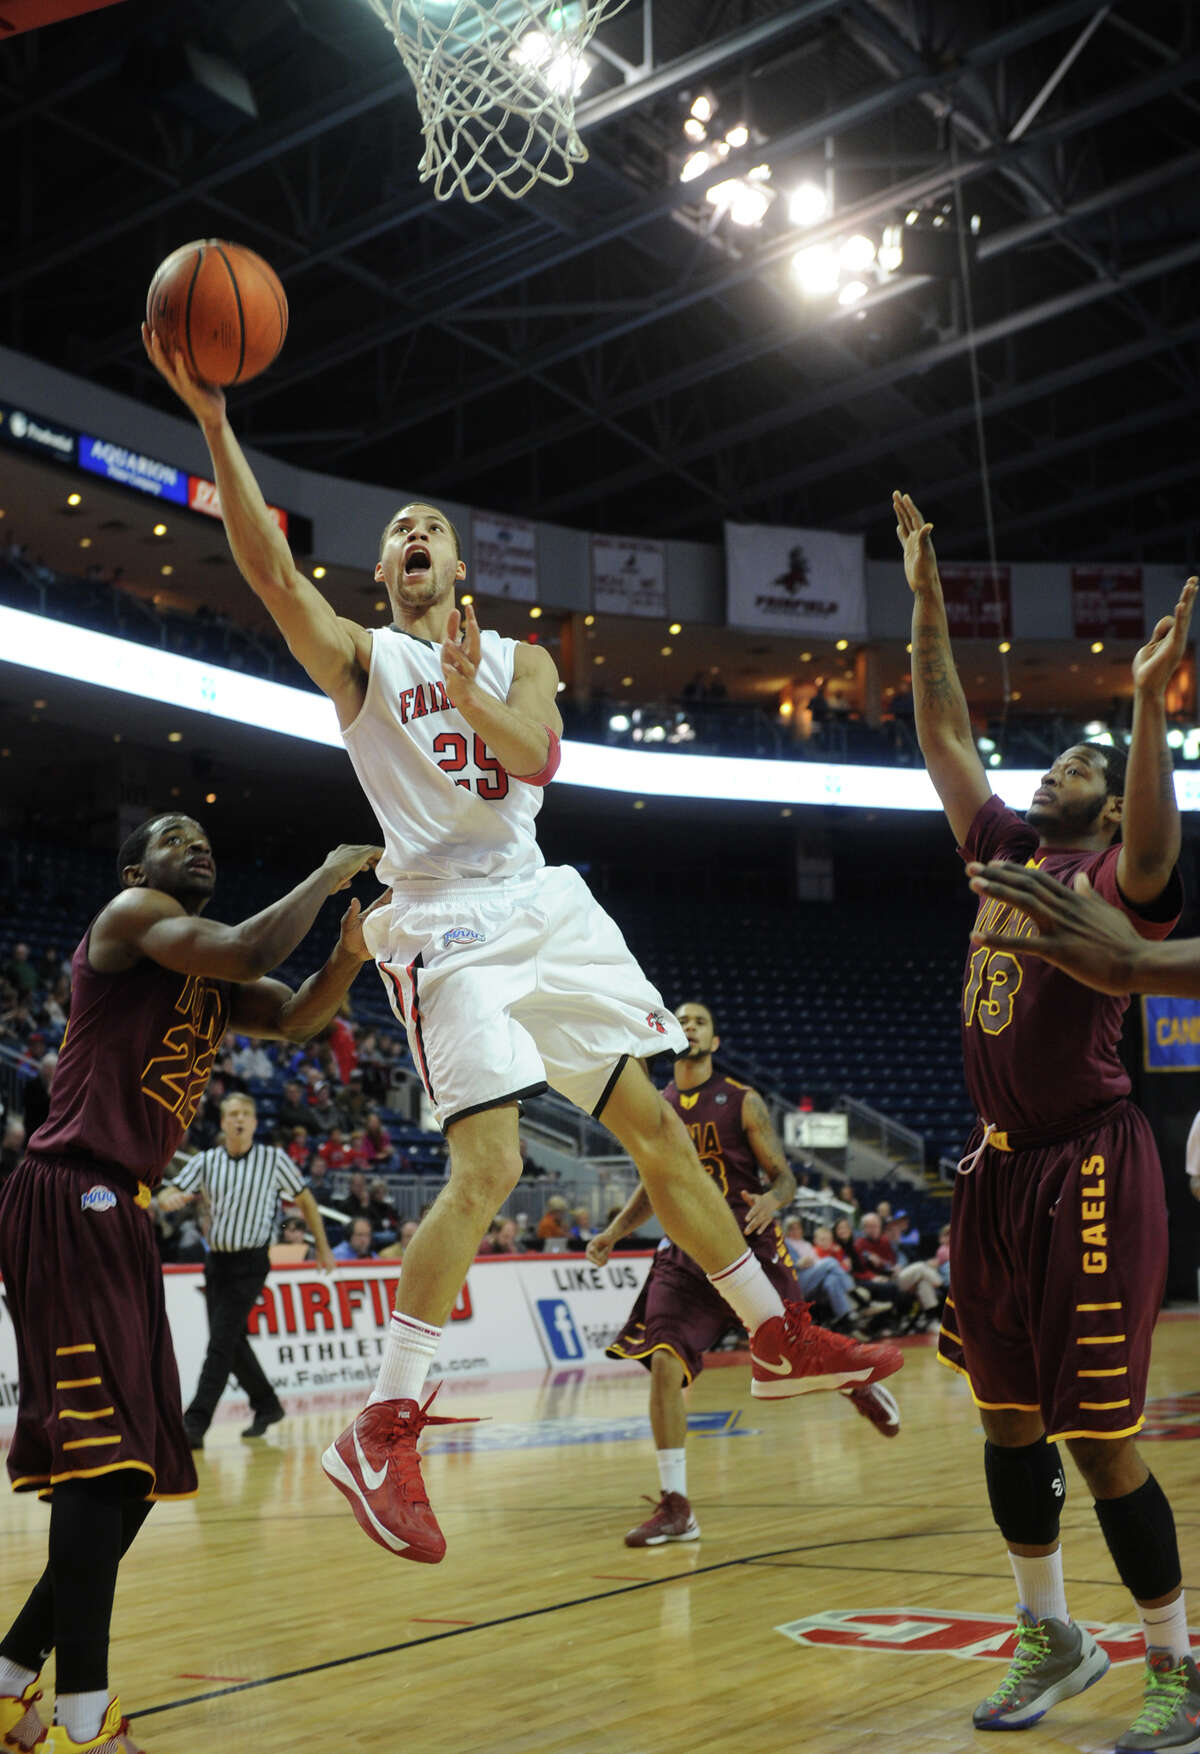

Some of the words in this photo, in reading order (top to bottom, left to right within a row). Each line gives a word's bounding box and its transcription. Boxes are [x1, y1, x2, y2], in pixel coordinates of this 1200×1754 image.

[433, 732, 509, 800] 25
[964, 946, 1024, 1036] 13
[1081, 1154, 1108, 1275] GAELS
[553, 1267, 604, 1291] LIKE
[608, 1266, 638, 1289] US
[278, 1337, 386, 1364] ATHLET
